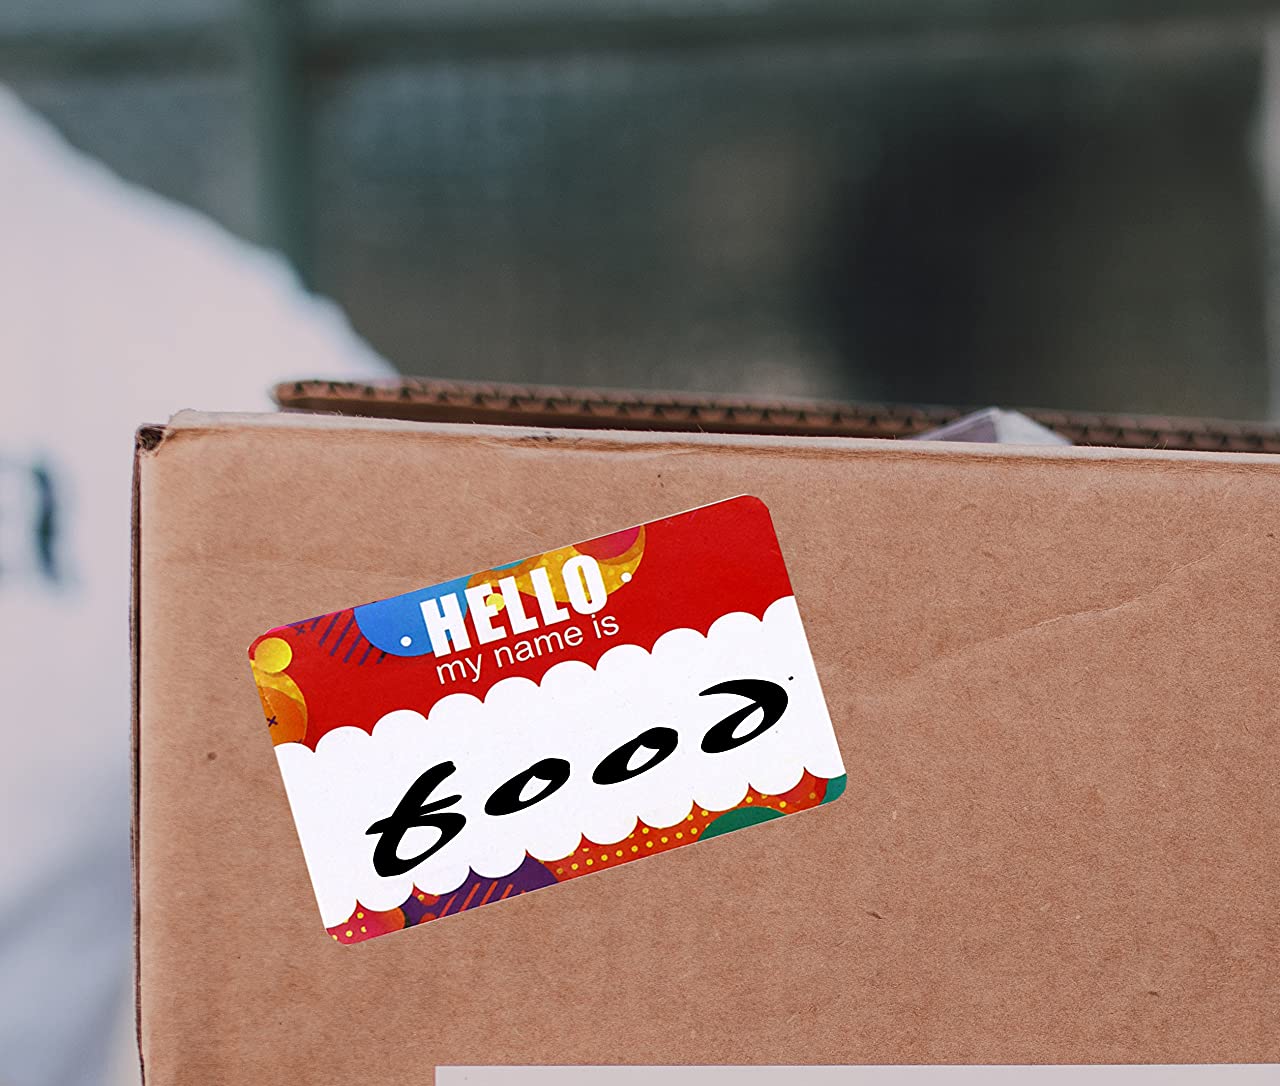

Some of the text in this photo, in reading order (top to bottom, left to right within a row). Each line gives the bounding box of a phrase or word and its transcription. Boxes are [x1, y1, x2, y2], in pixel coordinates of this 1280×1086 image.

[420, 554, 609, 658] HELLO
[436, 612, 620, 685] my name is
